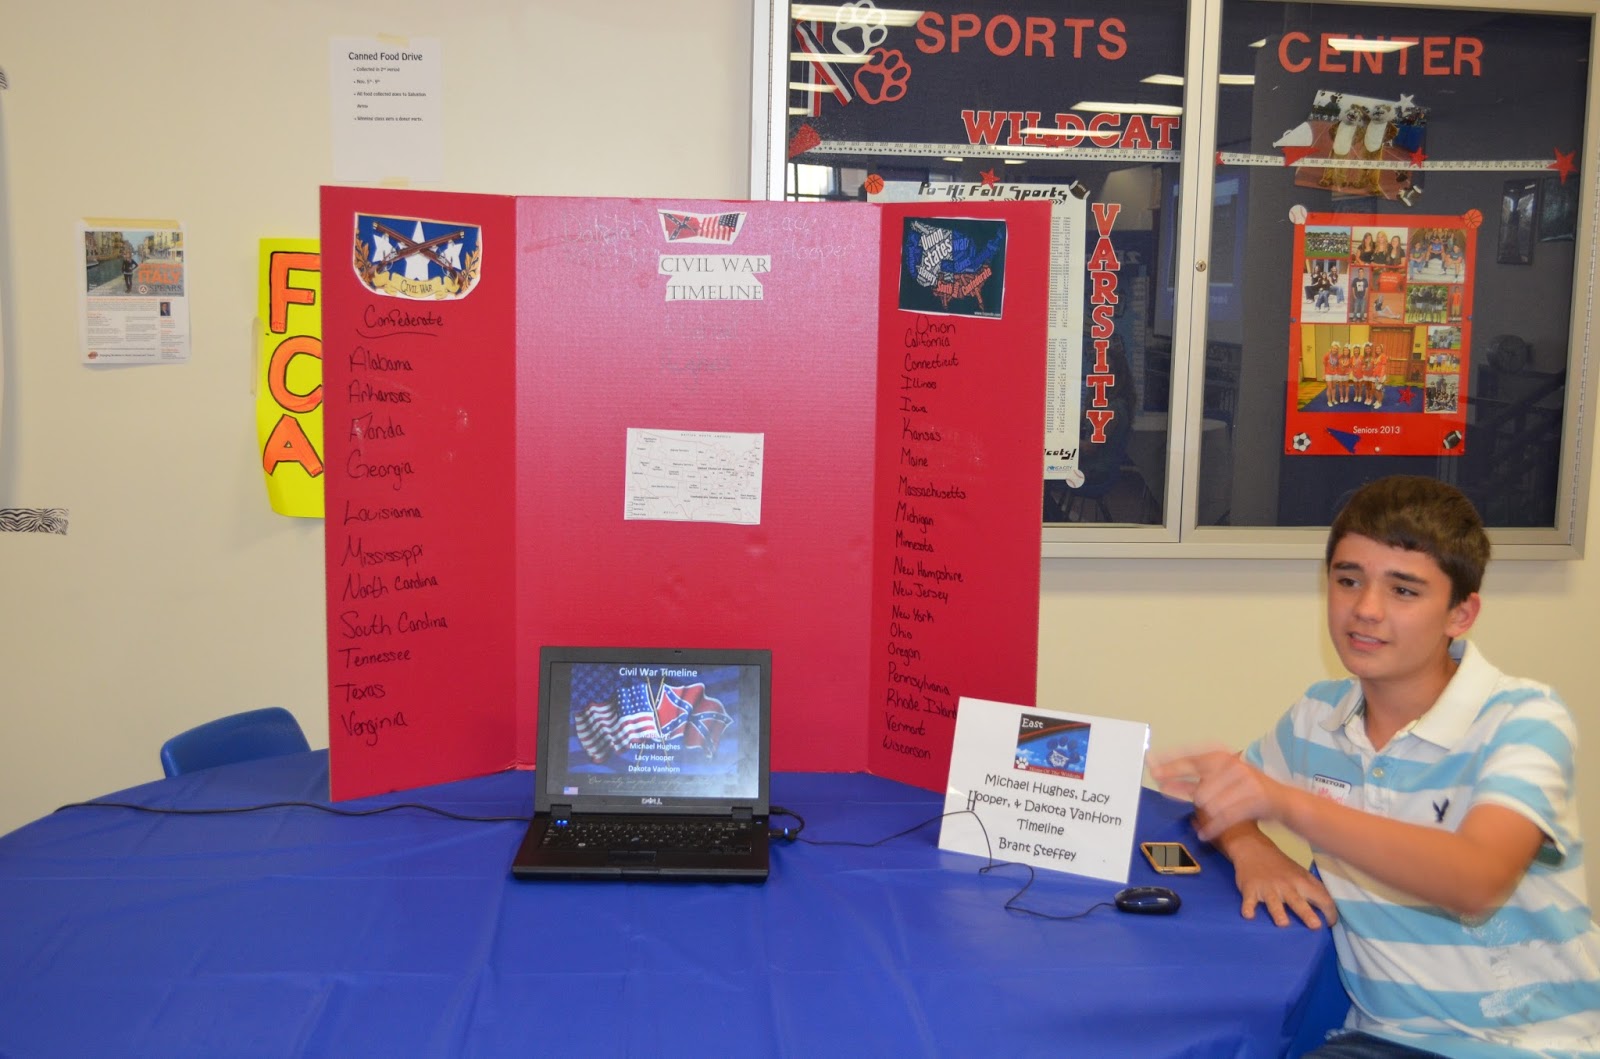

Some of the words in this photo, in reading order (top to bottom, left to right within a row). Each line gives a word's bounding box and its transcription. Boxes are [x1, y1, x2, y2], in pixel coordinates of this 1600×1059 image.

[914, 11, 1128, 61] SPORTS
[348, 52, 378, 61] Canned
[380, 52, 400, 61] Food
[401, 52, 423, 61] Drive
[1277, 31, 1484, 77] CENTER
[961, 109, 1180, 150] WILDCAT
[1009, 185, 1068, 201] Sports
[921, 228, 944, 251] Union
[660, 257, 714, 273] CIVIL
[722, 257, 770, 273] WAR
[138, 270, 182, 285] ITALY
[401, 280, 418, 294] CIVIL
[667, 285, 763, 300] TIMELINE
[364, 305, 443, 328] Confederate
[1086, 203, 1121, 443] VARSITY
[349, 346, 414, 372] Alabama
[348, 379, 412, 404] Arkansas
[899, 396, 928, 413] Iowa
[902, 417, 942, 442] Kansas
[1352, 425, 1378, 434] Seniors
[1380, 425, 1400, 434] 2013
[900, 447, 928, 467] Maine
[1044, 448, 1077, 460] cats!
[346, 449, 415, 491] Georgia
[895, 500, 934, 534] Michigan
[893, 556, 915, 576] New
[917, 560, 964, 584] Hampshire
[342, 573, 389, 601] North
[892, 581, 913, 597] New
[913, 583, 948, 604] Jersey
[341, 610, 392, 639] South
[891, 605, 911, 620] New
[913, 608, 934, 623] York
[890, 622, 913, 639] Ohio
[338, 647, 411, 668] Tennessee
[887, 642, 921, 666] Oregon
[619, 667, 638, 676] Civil
[640, 667, 658, 676] War
[660, 667, 698, 677] Timeline
[334, 682, 386, 702] Texas
[886, 688, 919, 711] Rhode
[1022, 717, 1044, 729] East
[629, 742, 656, 750] Michael
[657, 742, 681, 752] Hughes
[634, 754, 648, 763] Lacy
[650, 754, 675, 763] Hooper
[985, 773, 1029, 792] Michael
[1033, 782, 1078, 800] Hughes,
[1081, 789, 1110, 805] Lacy
[966, 790, 1011, 812] Hooper,
[1024, 799, 1066, 817] Dakota
[1070, 807, 1122, 826] VanHorn
[1016, 818, 1065, 836] Timeline
[999, 836, 1031, 853] Brant
[1033, 843, 1077, 862] Steffey
